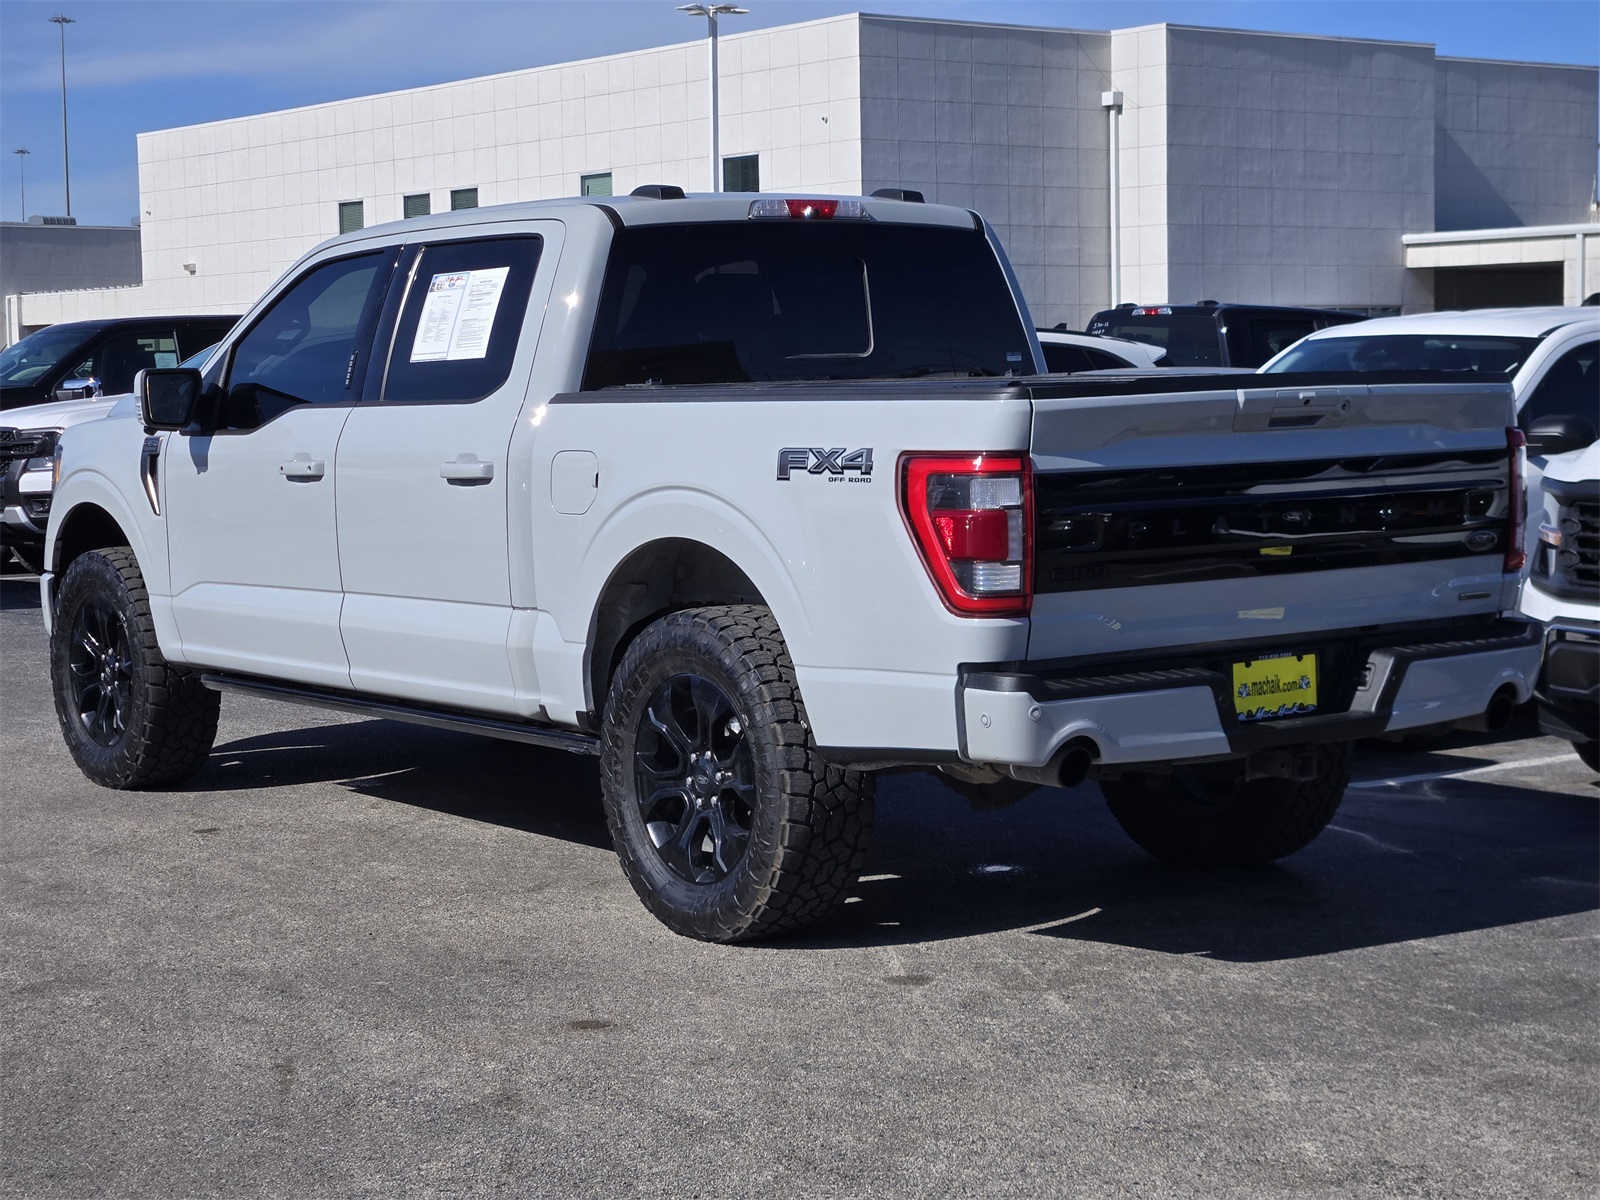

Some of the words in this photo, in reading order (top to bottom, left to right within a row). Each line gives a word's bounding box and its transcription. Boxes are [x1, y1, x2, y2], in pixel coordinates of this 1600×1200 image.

[776, 447, 874, 481] FX4
[848, 476, 872, 484] ROAD
[1251, 673, 1298, 697] machaik.com
